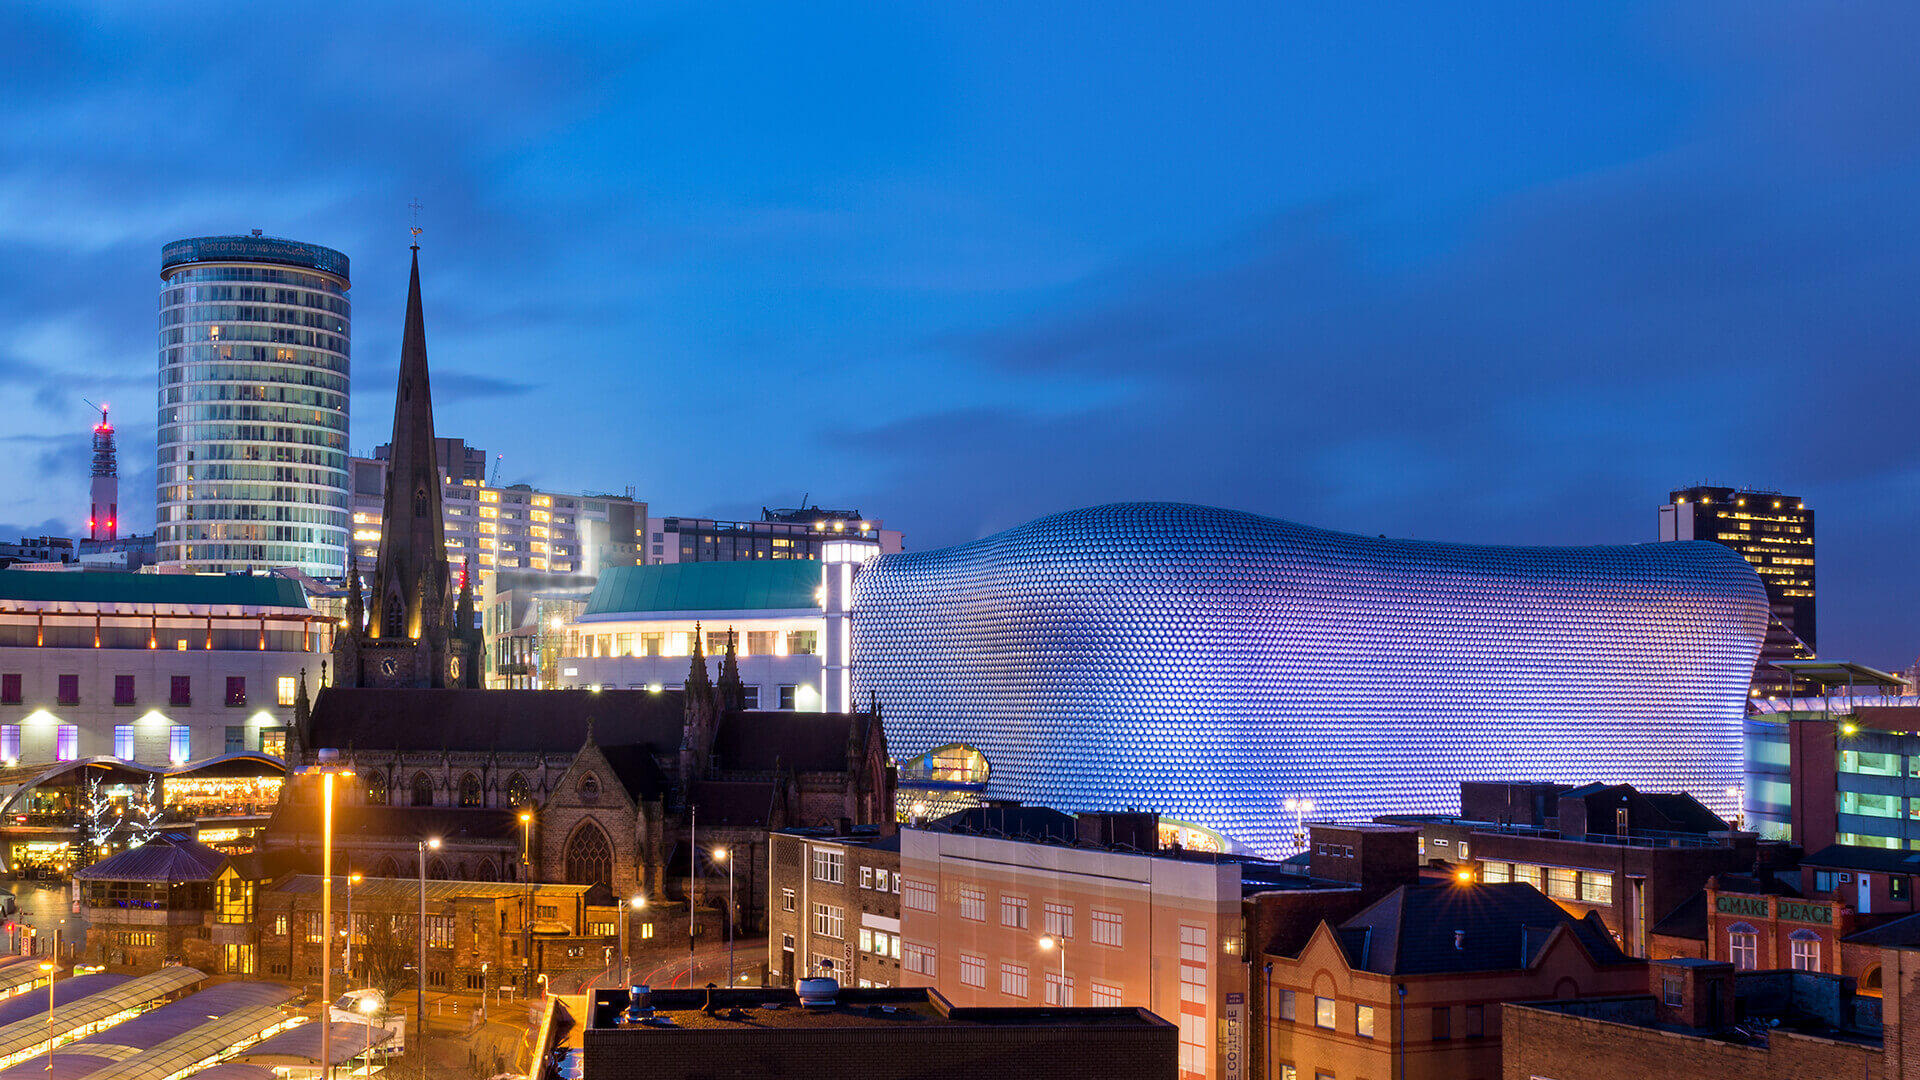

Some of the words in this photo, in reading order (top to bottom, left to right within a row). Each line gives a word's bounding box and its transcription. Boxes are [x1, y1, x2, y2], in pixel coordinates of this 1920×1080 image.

[231, 241, 248, 253] buy
[1777, 902, 1833, 924] PEACE
[1227, 1009, 1237, 1071] COLLEGE
